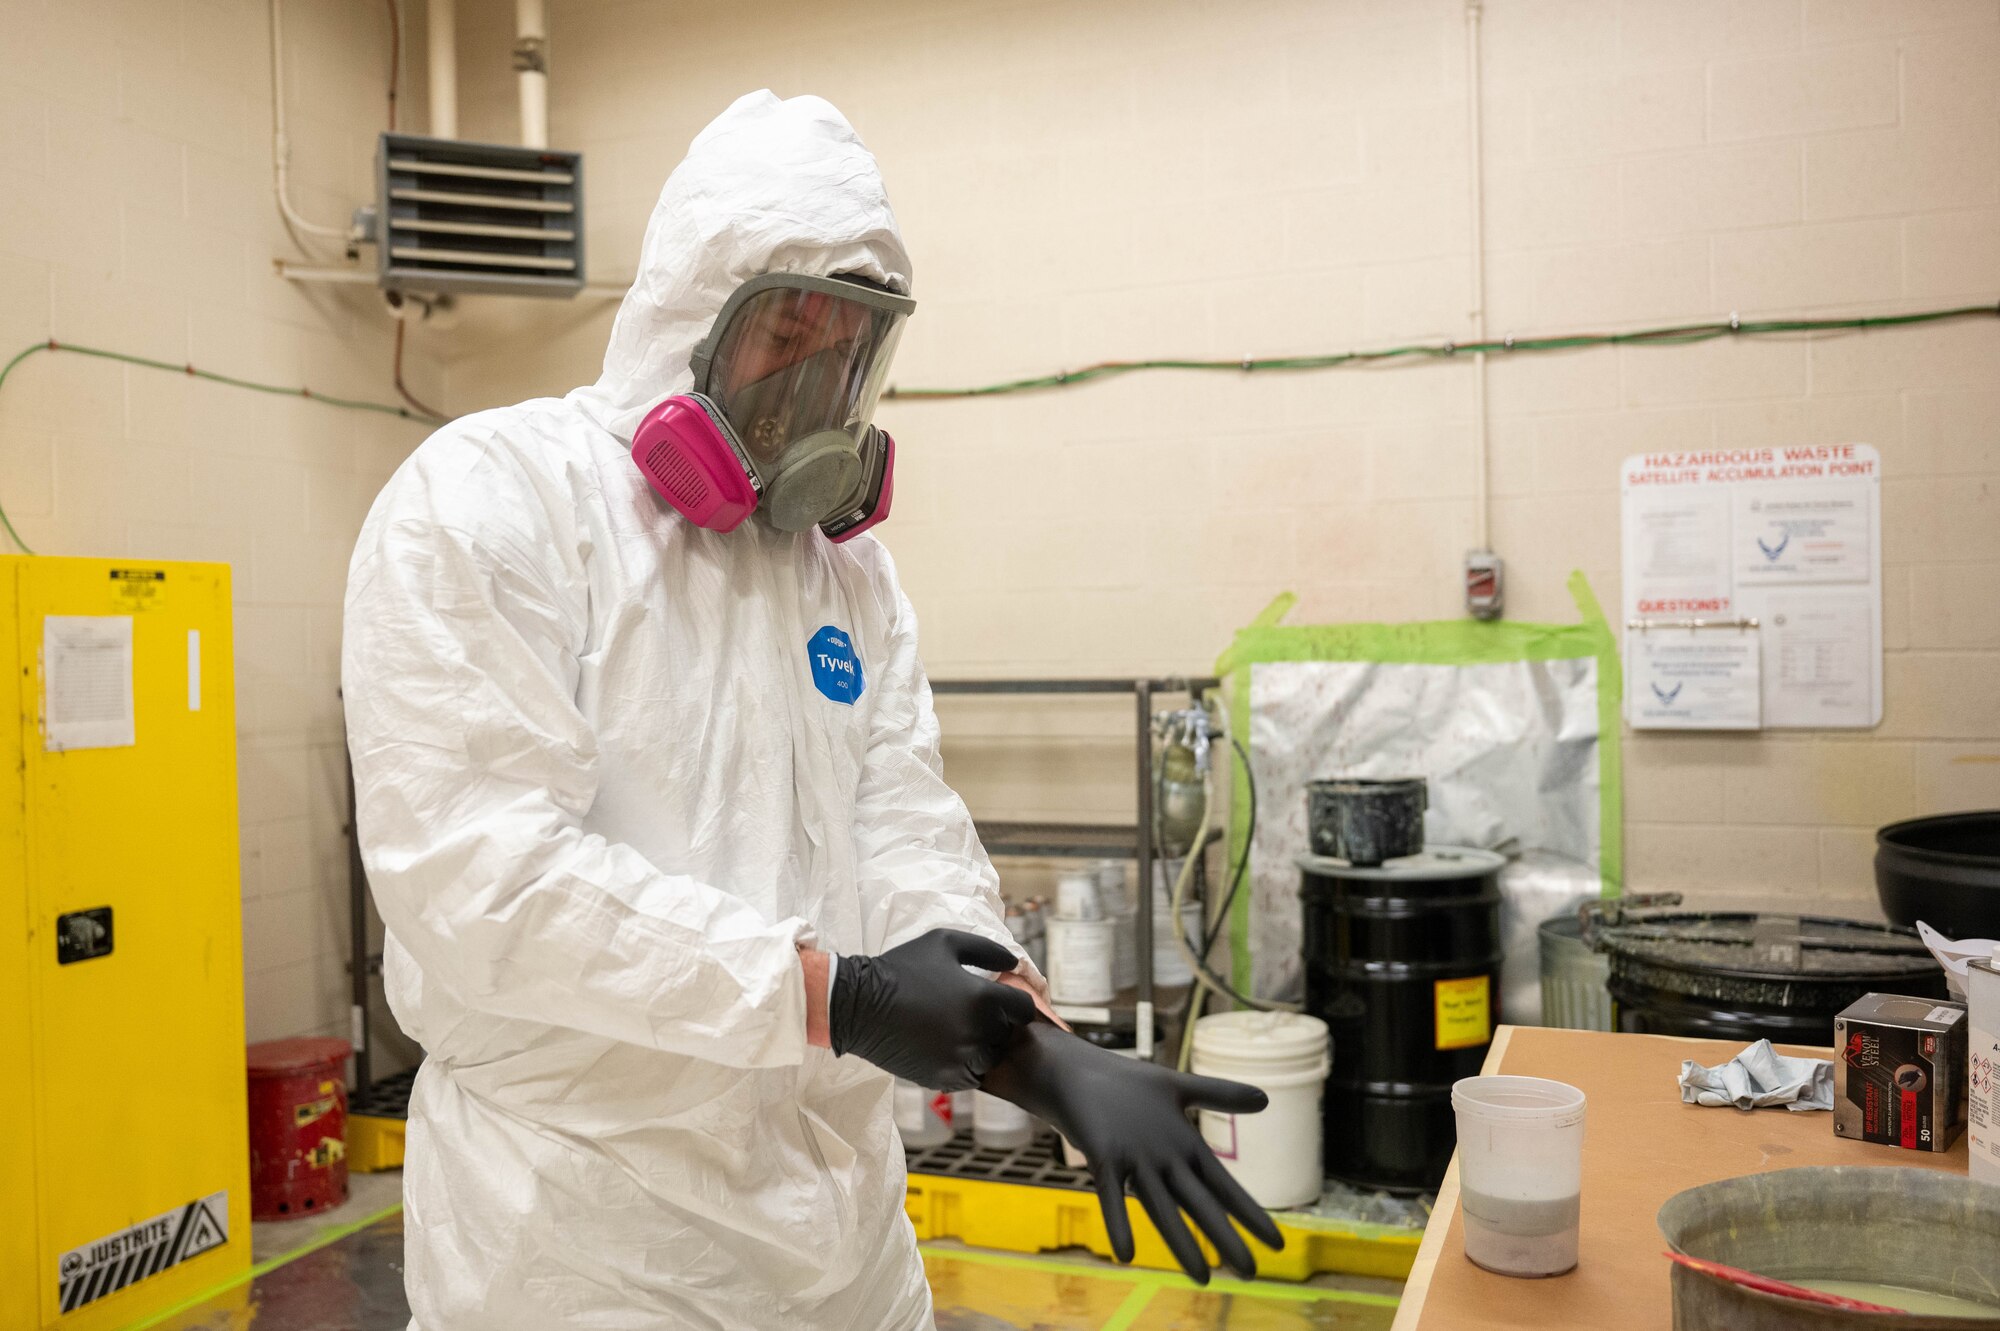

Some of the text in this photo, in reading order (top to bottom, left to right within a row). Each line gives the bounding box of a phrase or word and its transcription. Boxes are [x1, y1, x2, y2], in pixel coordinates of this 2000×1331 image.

[1645, 444, 1855, 468] HAZARDOUS WASTE
[1628, 461, 1874, 486] SATELLITE ACCUMULATION POINT
[1637, 598, 1730, 613] QUESTIONS?
[817, 653, 856, 676] Tyvek
[1861, 1035, 1871, 1067] VENOM
[1871, 1037, 1880, 1066] STEEL
[1865, 1081, 1874, 1120] RESISTANT
[1920, 1129, 1930, 1142] 50
[85, 1219, 170, 1267] JUSTRITE
